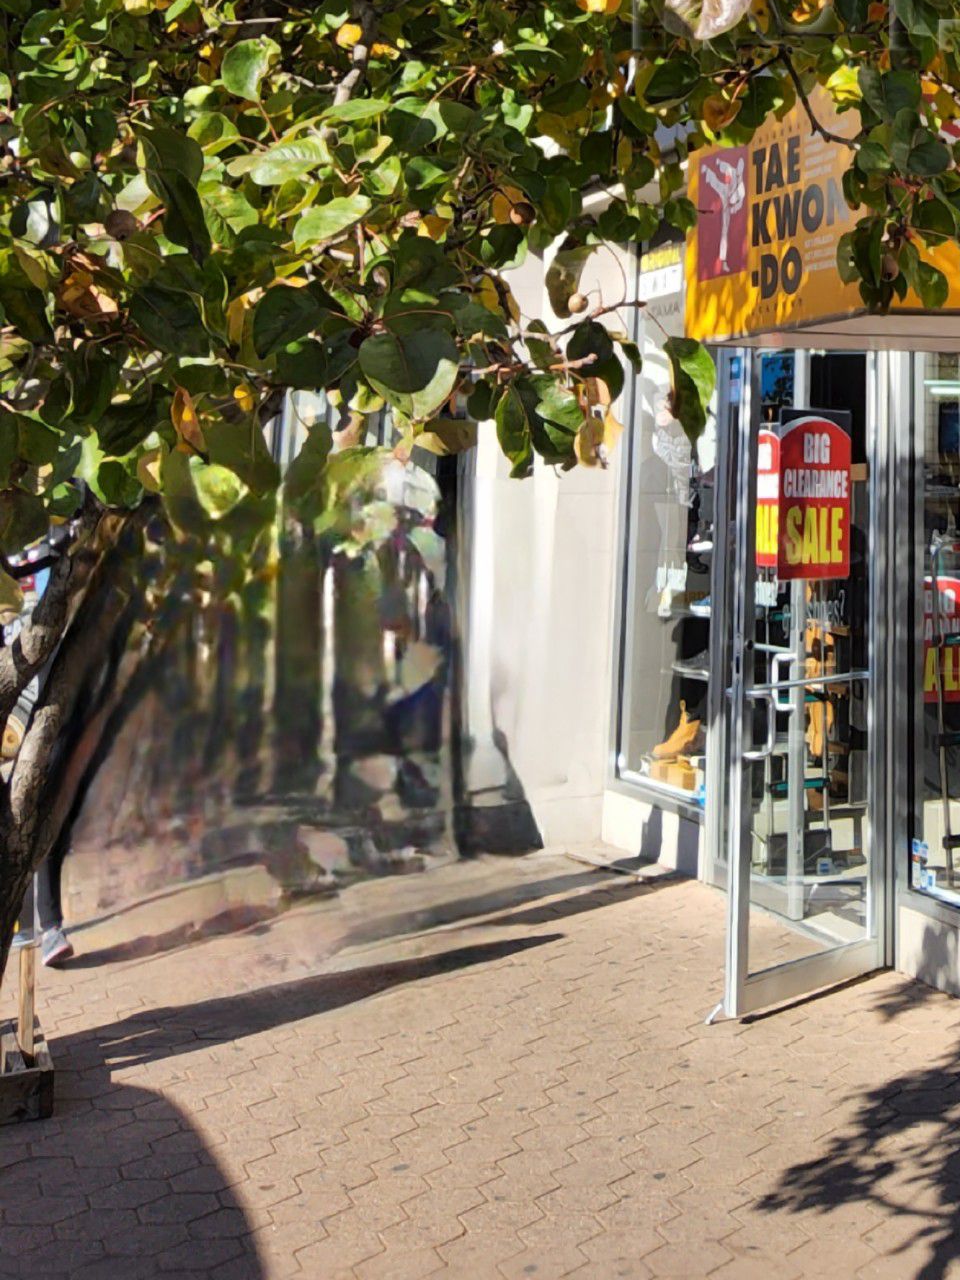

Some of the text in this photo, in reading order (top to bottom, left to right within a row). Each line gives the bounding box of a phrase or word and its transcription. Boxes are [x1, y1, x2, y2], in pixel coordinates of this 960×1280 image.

[752, 136, 800, 195] TAE
[752, 176, 850, 247] KWON
[803, 432, 830, 464] BIG
[783, 468, 848, 498] CLEARANCE
[785, 505, 844, 565] SALE
